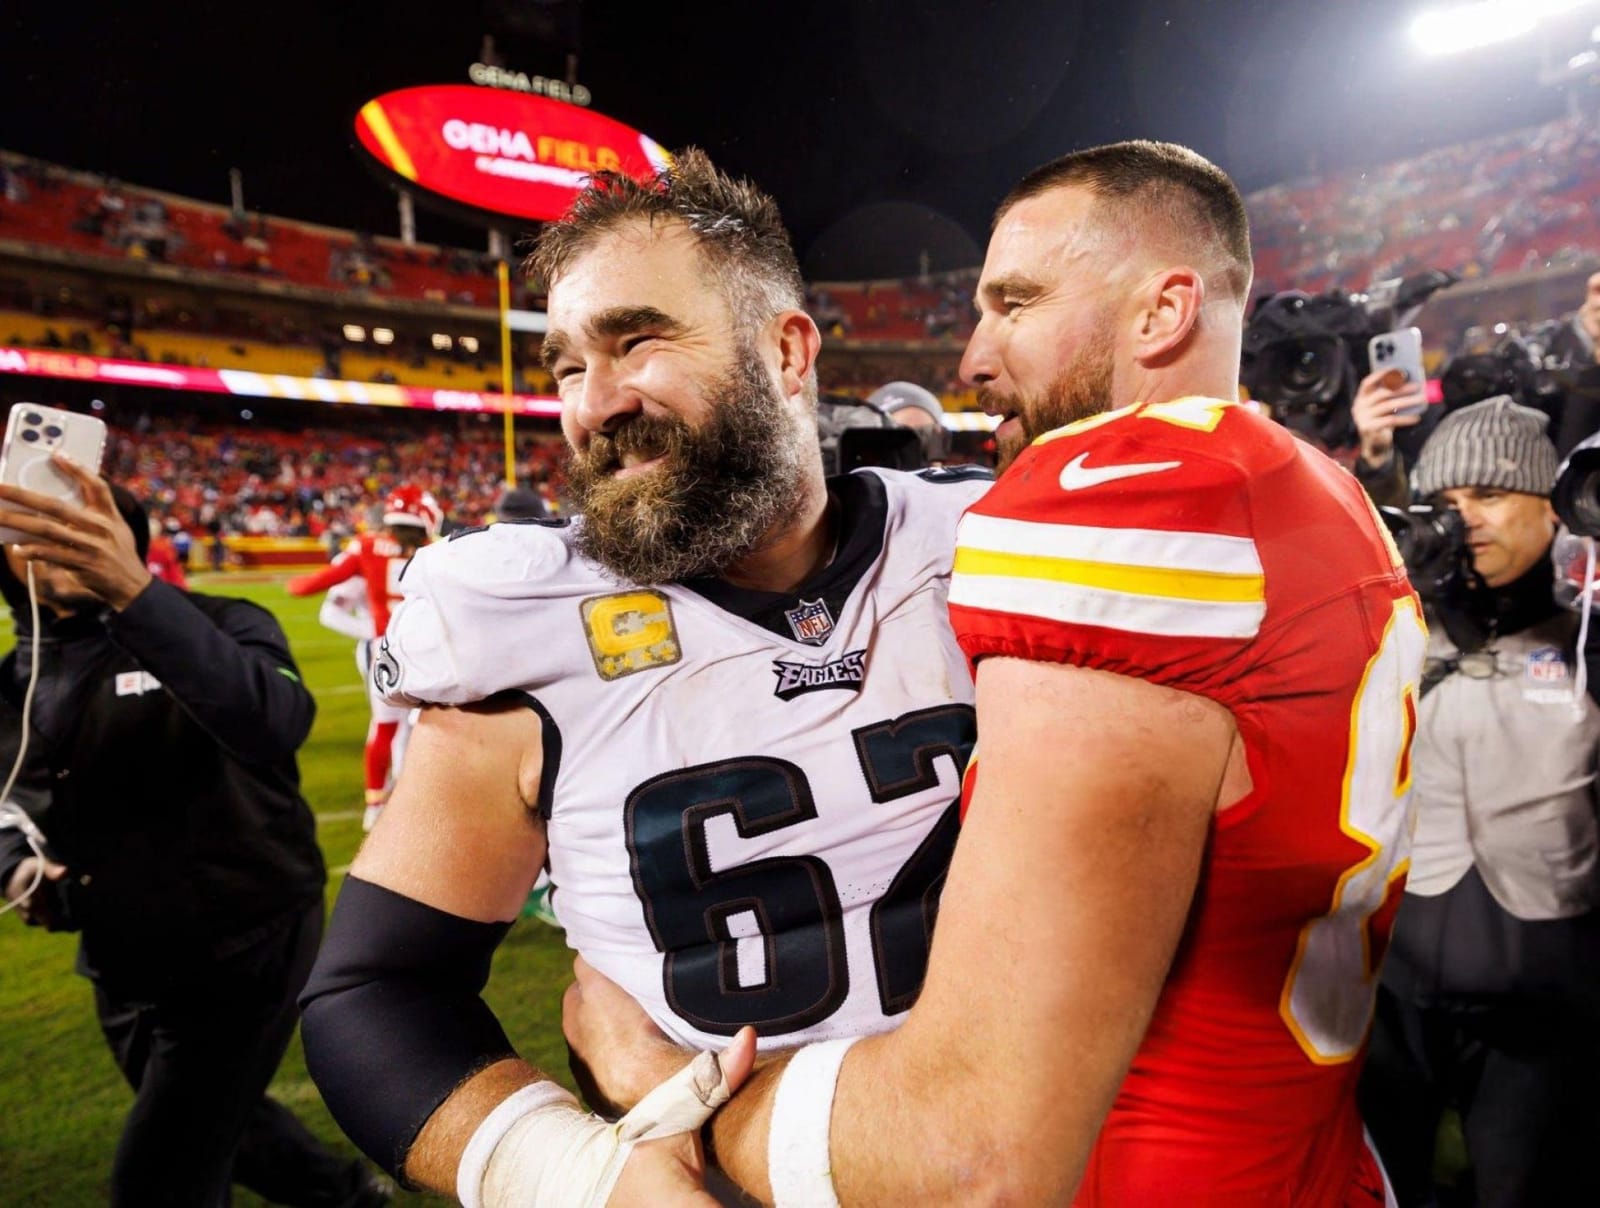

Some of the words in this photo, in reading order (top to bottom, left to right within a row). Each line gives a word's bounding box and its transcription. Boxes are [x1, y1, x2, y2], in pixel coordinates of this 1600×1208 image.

[532, 75, 591, 106] FIELD
[798, 615, 830, 637] NFL
[773, 650, 866, 694] EAGLES
[623, 703, 977, 1037] 62
